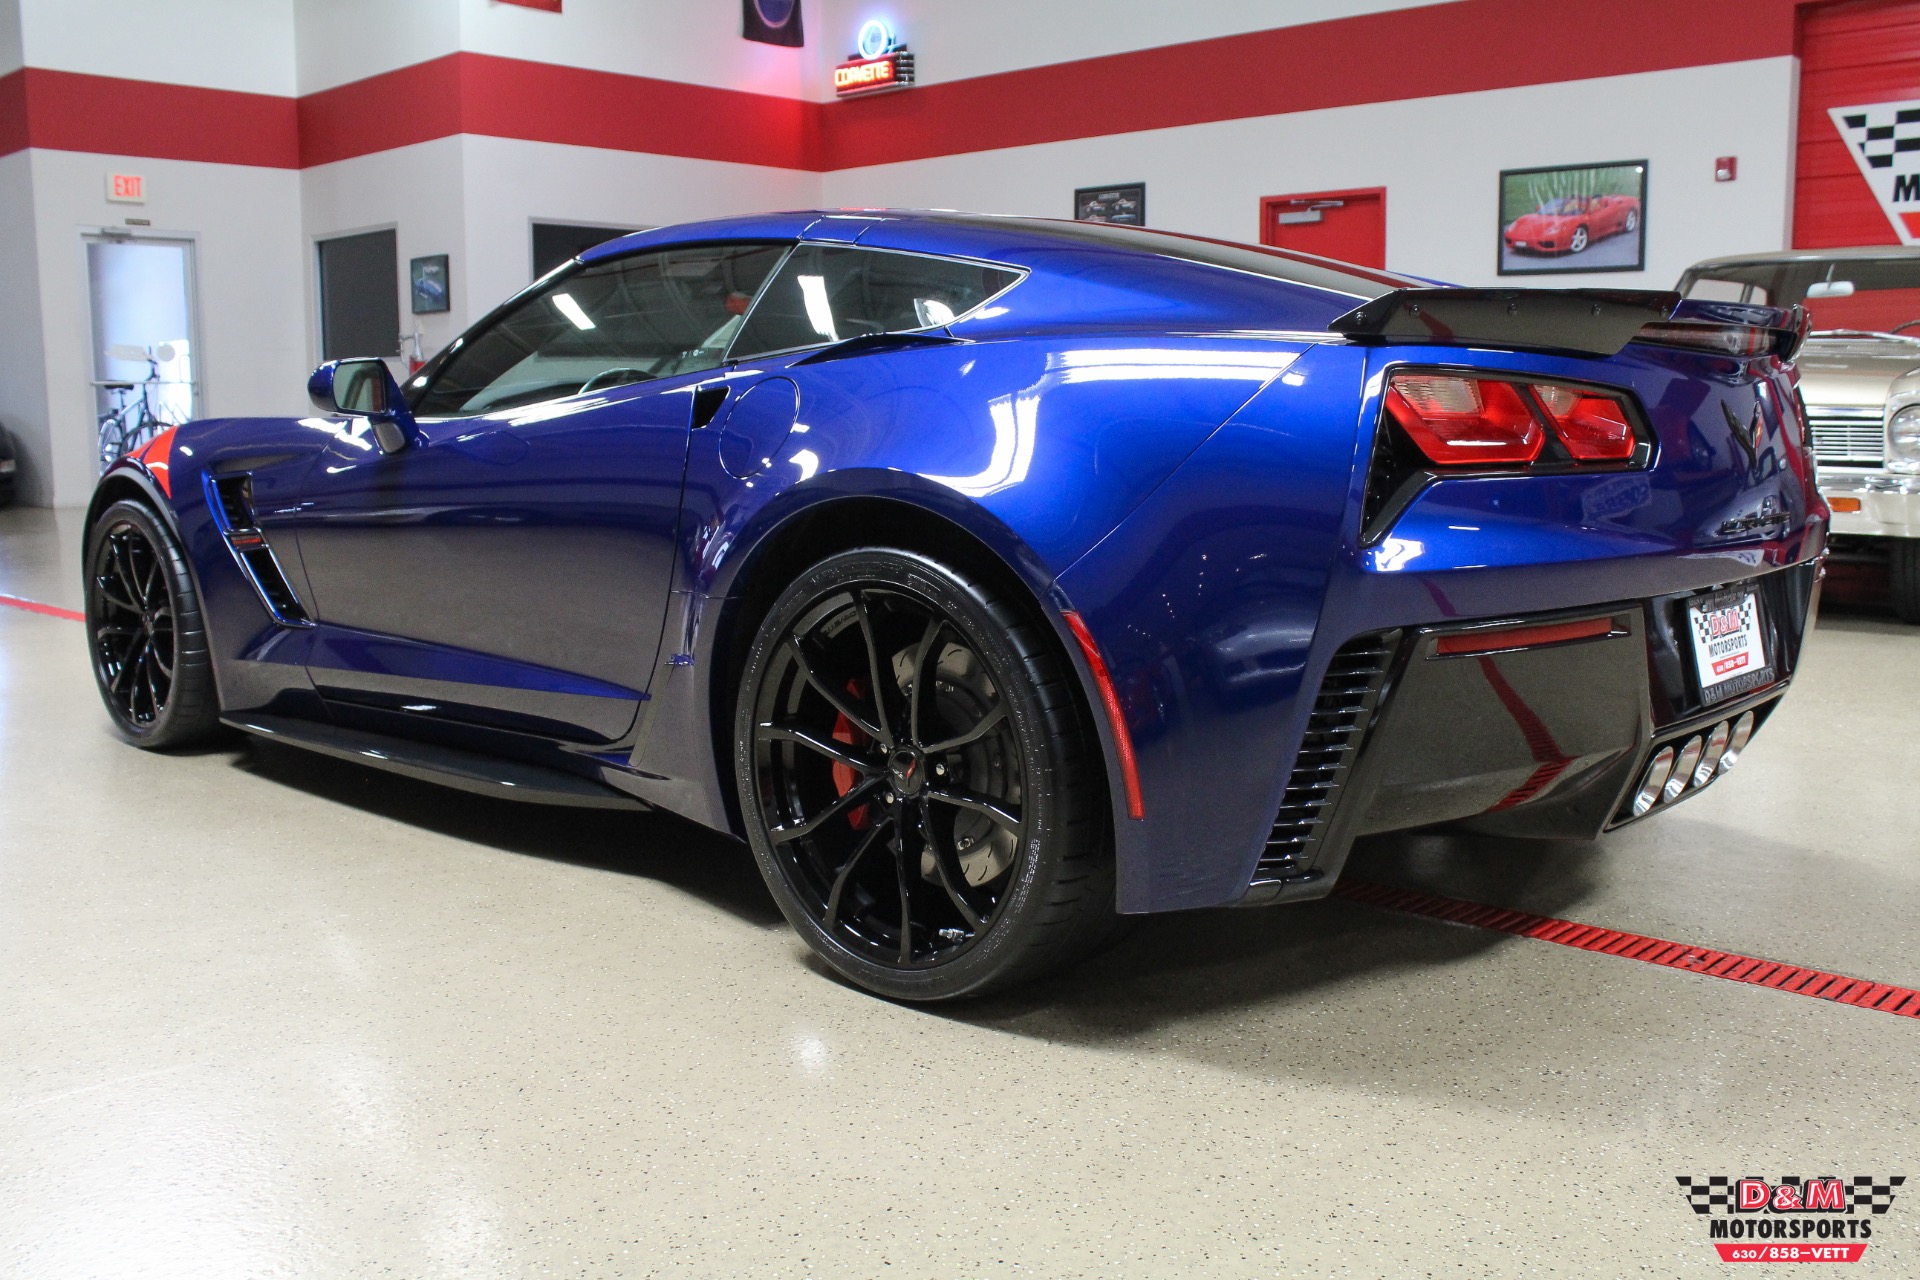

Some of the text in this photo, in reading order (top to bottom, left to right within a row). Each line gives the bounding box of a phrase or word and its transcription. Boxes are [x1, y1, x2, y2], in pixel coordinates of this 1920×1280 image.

[114, 175, 142, 197] EXIT
[1710, 609, 1740, 640] D&M
[1708, 634, 1748, 658] MOTORSPORTS
